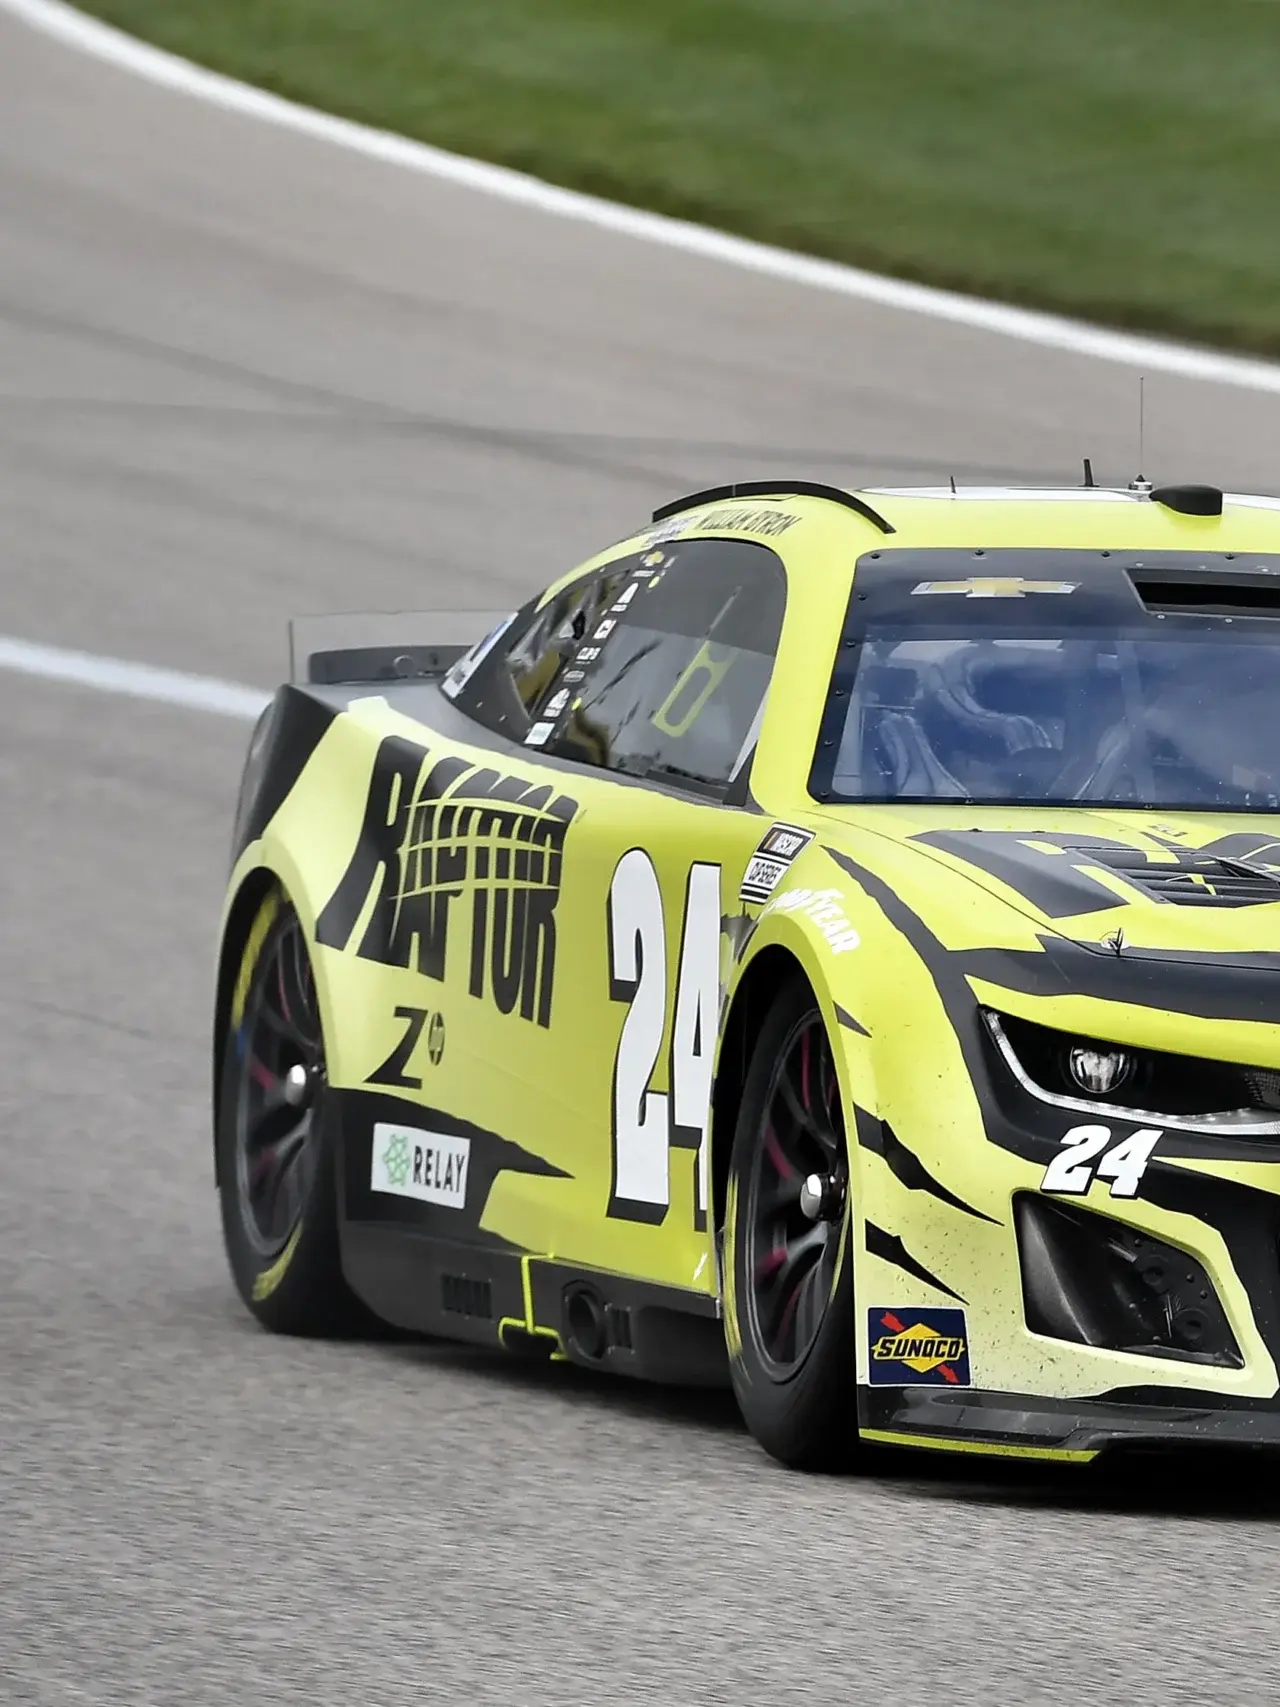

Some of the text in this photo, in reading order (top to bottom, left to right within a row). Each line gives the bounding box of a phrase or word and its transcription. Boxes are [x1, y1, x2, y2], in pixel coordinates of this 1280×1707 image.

[315, 735, 579, 1030] RAPTOR
[606, 846, 722, 1232] 24
[413, 1145, 466, 1194] RELAY
[1040, 1124, 1164, 1200] 24
[876, 1338, 962, 1359] SUNOCO
